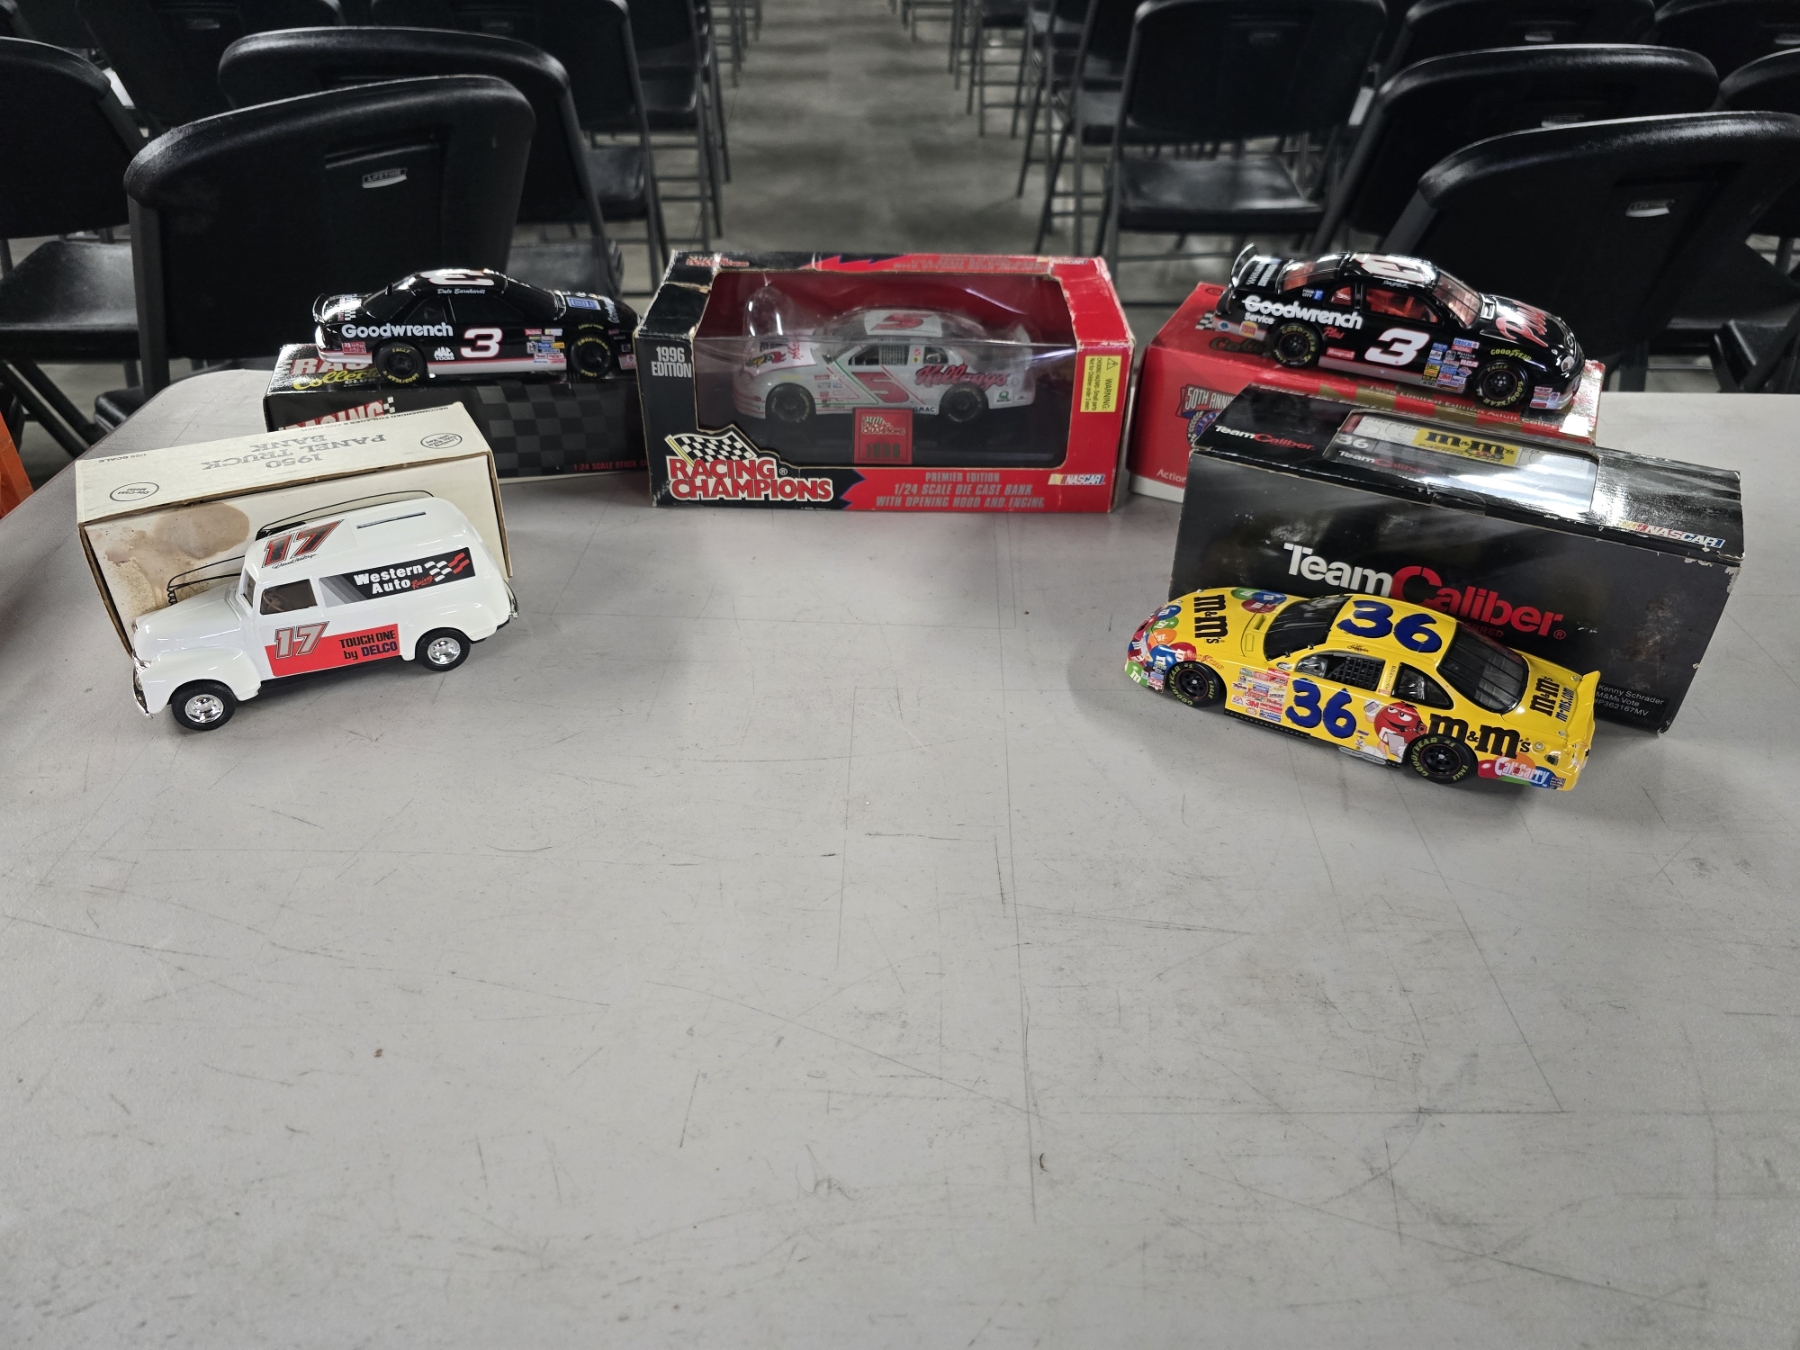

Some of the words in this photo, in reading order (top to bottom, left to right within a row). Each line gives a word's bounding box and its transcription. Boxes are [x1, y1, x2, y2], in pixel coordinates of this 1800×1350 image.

[1242, 294, 1363, 330] Goodwrench
[1244, 312, 1276, 325] Service
[341, 322, 454, 338] Goodwrench
[1322, 326, 1346, 340] Plus
[460, 327, 503, 359] 3
[1364, 327, 1430, 366] 3
[656, 347, 686, 362] 1996
[1490, 348, 1532, 361] GOODYEAR
[651, 361, 692, 378] EDITION
[852, 371, 910, 403] 5
[1184, 386, 1210, 410] 50TH
[1443, 401, 1485, 414] Edition
[1487, 409, 1519, 422] Adult
[250, 434, 328, 453] BANK
[299, 433, 387, 453] PANEL
[1335, 435, 1369, 450] 36
[200, 448, 294, 471] TRUCK
[266, 451, 323, 469] 1950
[592, 462, 613, 470] SCALE
[615, 461, 637, 469] STOCK
[667, 457, 775, 480] RACING
[925, 472, 963, 482] PREMIER
[966, 472, 1000, 482] EDITION
[1065, 475, 1104, 485] NASCAR
[671, 477, 833, 500] CHAMPIONS
[894, 485, 918, 495] 1/24
[921, 484, 952, 495] SCALE
[955, 485, 973, 495] DIE
[975, 485, 1001, 495] CAST
[1003, 485, 1033, 495] BANK
[876, 497, 902, 507] WITH
[905, 497, 950, 507] OPENING
[952, 497, 981, 507] HOOD
[984, 497, 1006, 507] AND
[1008, 498, 1045, 508] ENGINE
[261, 519, 344, 569] 17
[1647, 525, 1717, 548] NASCAR
[354, 563, 423, 586] Western
[372, 577, 411, 595] Auto
[1283, 542, 1564, 637] TeamCaliber
[1337, 599, 1443, 654] 36
[275, 621, 330, 660] 17
[339, 633, 376, 649] TOUCH
[376, 629, 397, 643] ONE
[343, 650, 359, 661] by
[362, 641, 398, 657] DELCO
[1168, 665, 1194, 706] GOODYEAR
[1598, 684, 1624, 697] Kenny
[1625, 690, 1665, 706] Schrader
[1285, 677, 1357, 739] 36
[1621, 697, 1640, 707] Vote
[1428, 713, 1531, 759] m&m's
[1410, 736, 1438, 777] GOODYEAR
[1452, 765, 1469, 781] EAGLE
